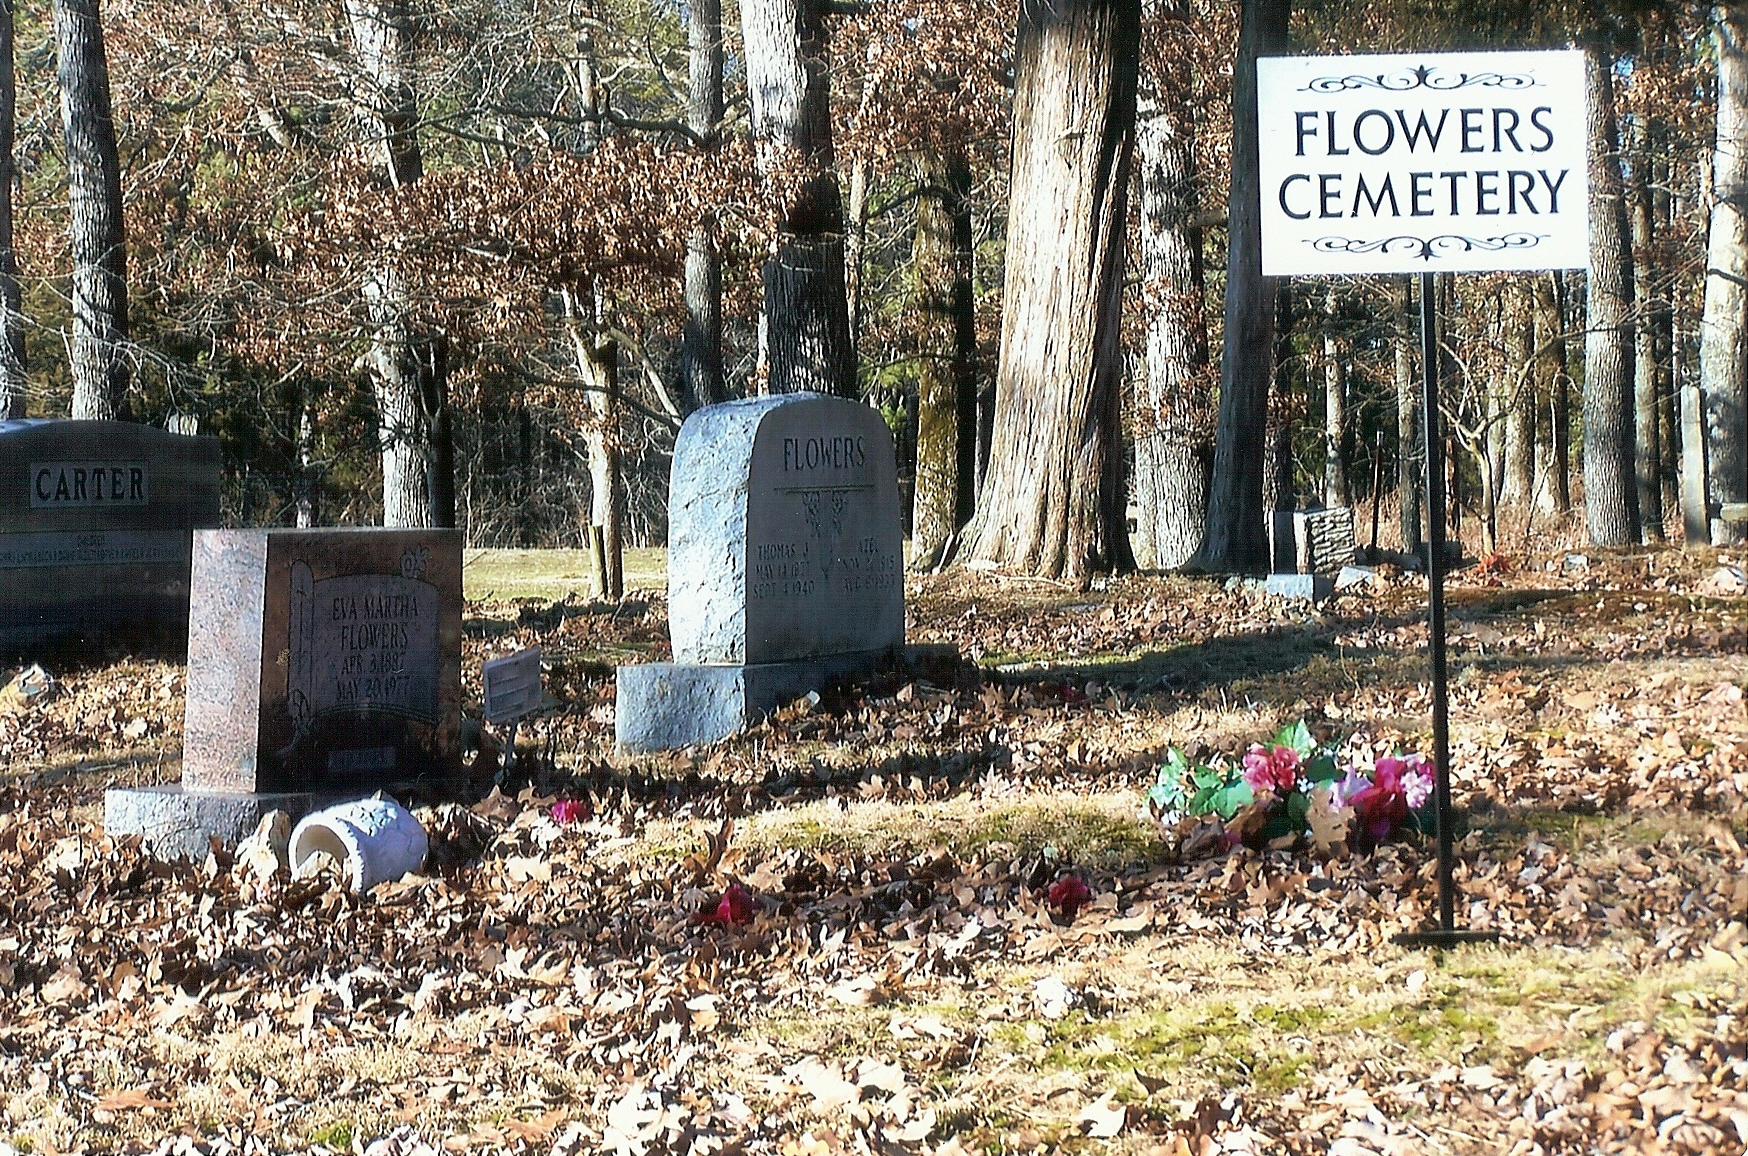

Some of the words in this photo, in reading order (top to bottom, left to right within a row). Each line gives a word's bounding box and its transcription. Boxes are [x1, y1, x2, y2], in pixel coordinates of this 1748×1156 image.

[1294, 106, 1554, 156] FLOWERS
[1278, 169, 1569, 219] CEMETERY
[783, 436, 865, 471] FLOWERS
[35, 467, 144, 500] CARTER
[757, 543, 796, 561] THOMAS
[332, 597, 358, 621] EVA
[364, 594, 419, 619] MARTHA
[340, 622, 409, 651] FLOWERS
